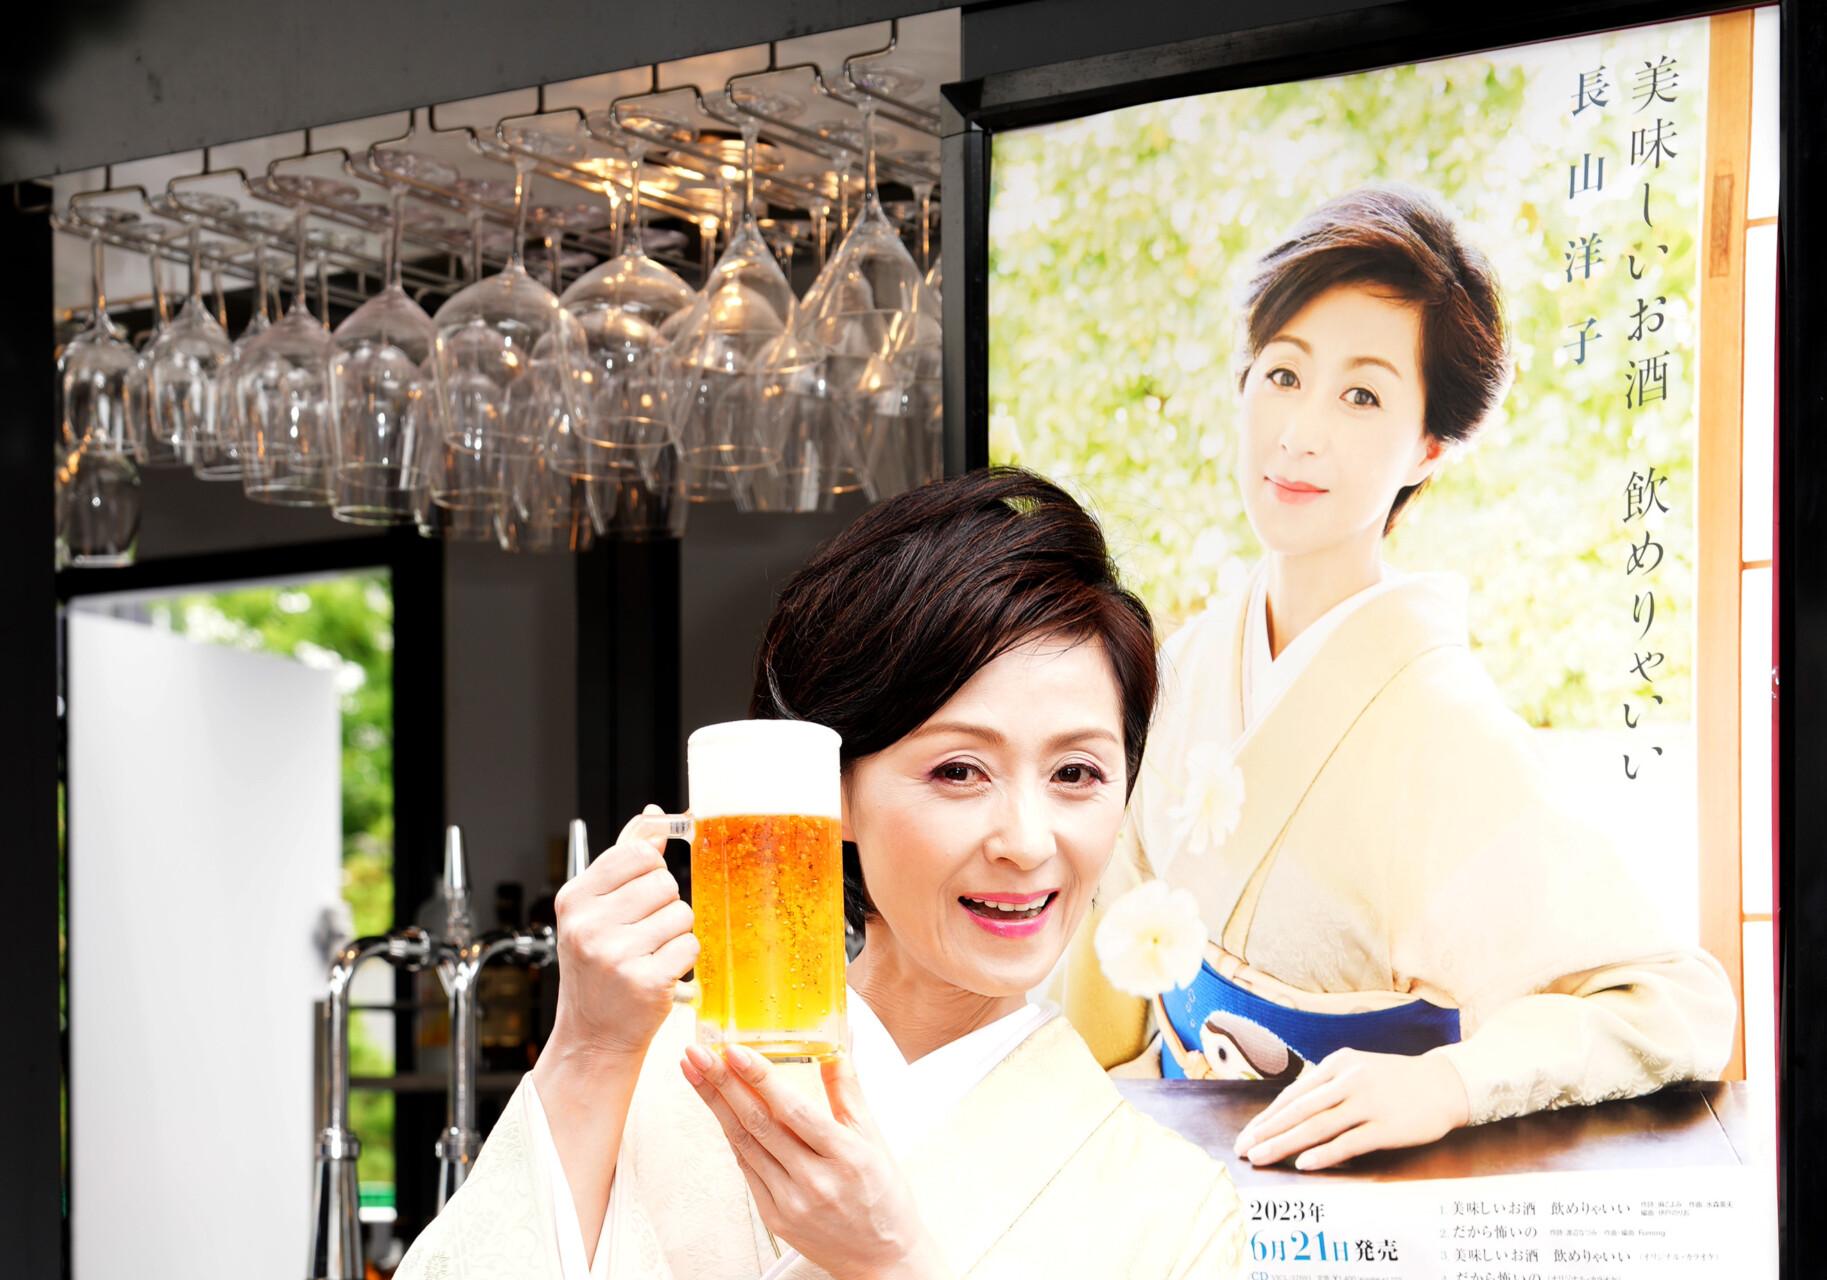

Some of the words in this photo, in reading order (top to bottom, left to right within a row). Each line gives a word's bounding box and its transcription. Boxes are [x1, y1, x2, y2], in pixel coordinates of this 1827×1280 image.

[1564, 65, 1610, 366] 長山洋子
[1625, 55, 1679, 410] 美味しいお酒
[1622, 467, 1670, 780] 飲めりゃいい
[1250, 1199, 1326, 1224] 2023年
[1453, 1200, 1536, 1216] 美味しいお酒
[1551, 1201, 1631, 1216] 飲めりゃいい
[1453, 1224, 1538, 1240] だから怖いの
[1455, 1247, 1539, 1263] 美味しいお酒
[1553, 1248, 1631, 1264] 飲めりゃいい
